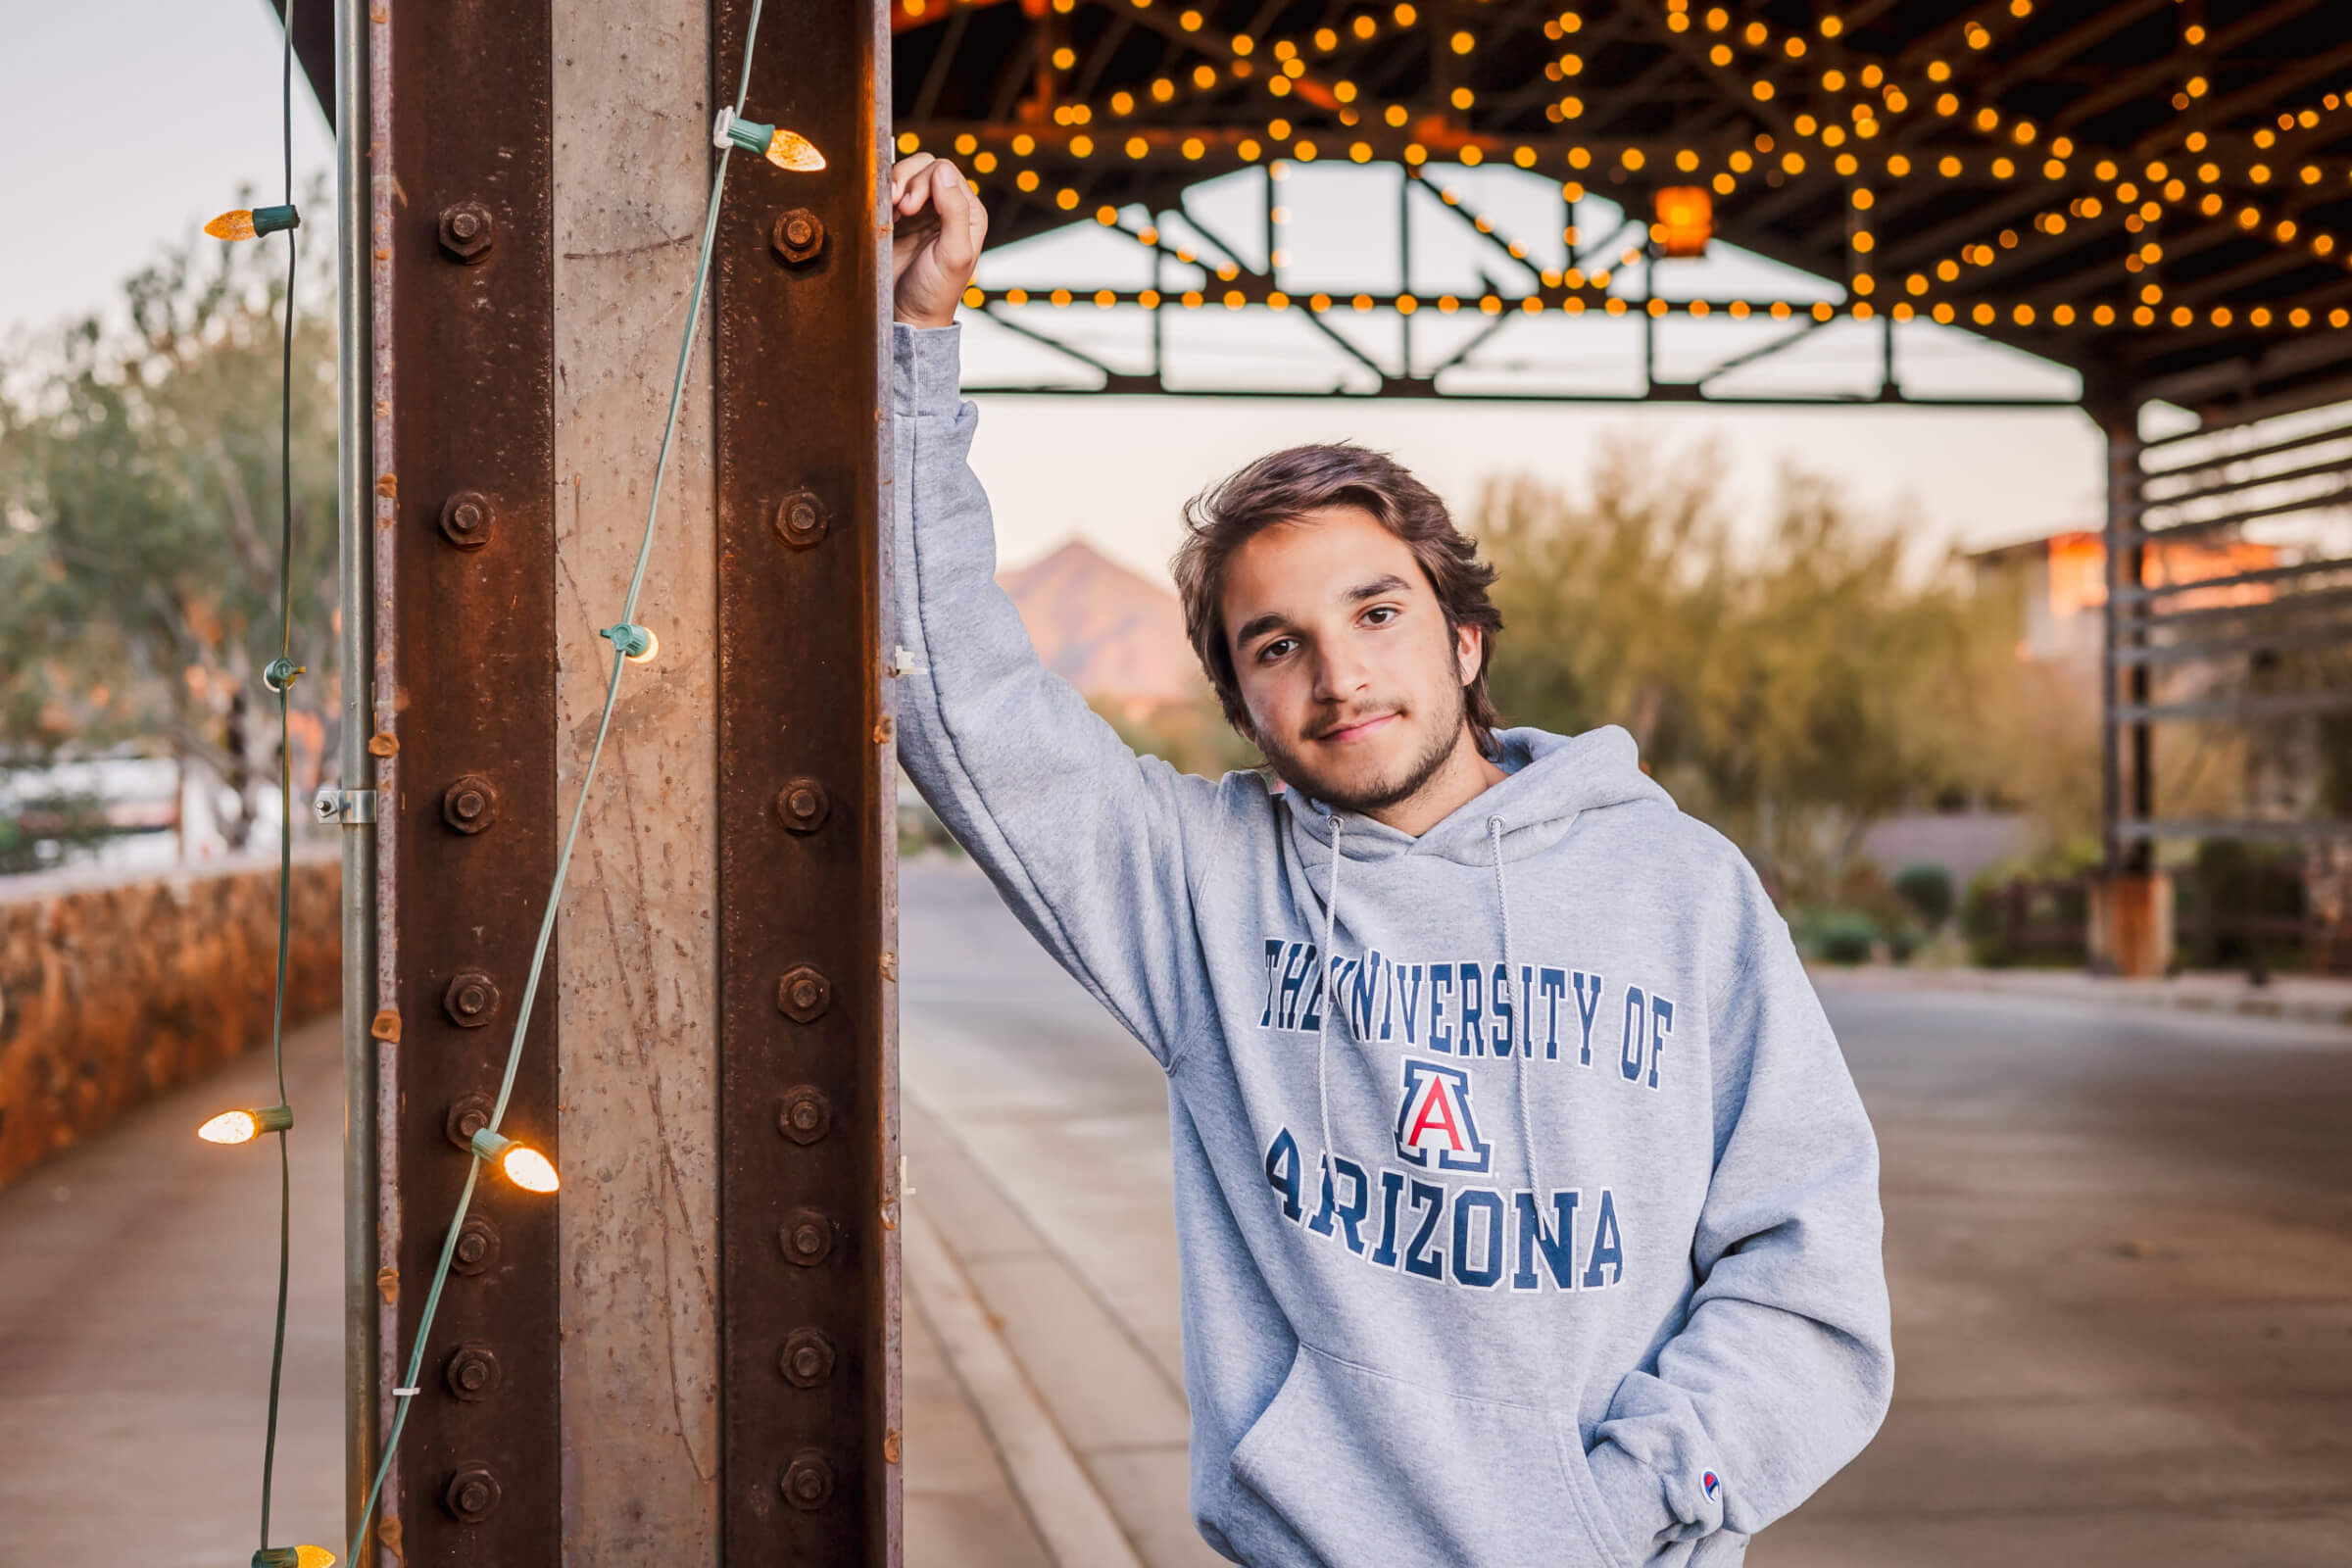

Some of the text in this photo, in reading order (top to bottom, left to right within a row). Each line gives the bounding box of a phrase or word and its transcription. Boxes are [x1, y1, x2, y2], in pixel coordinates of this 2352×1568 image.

[1329, 948, 1603, 1068] UNIVERSITY
[1620, 984, 1674, 1091] OF
[1395, 1054, 1494, 1178] A
[1264, 1122, 1625, 1294] ARIZONA
